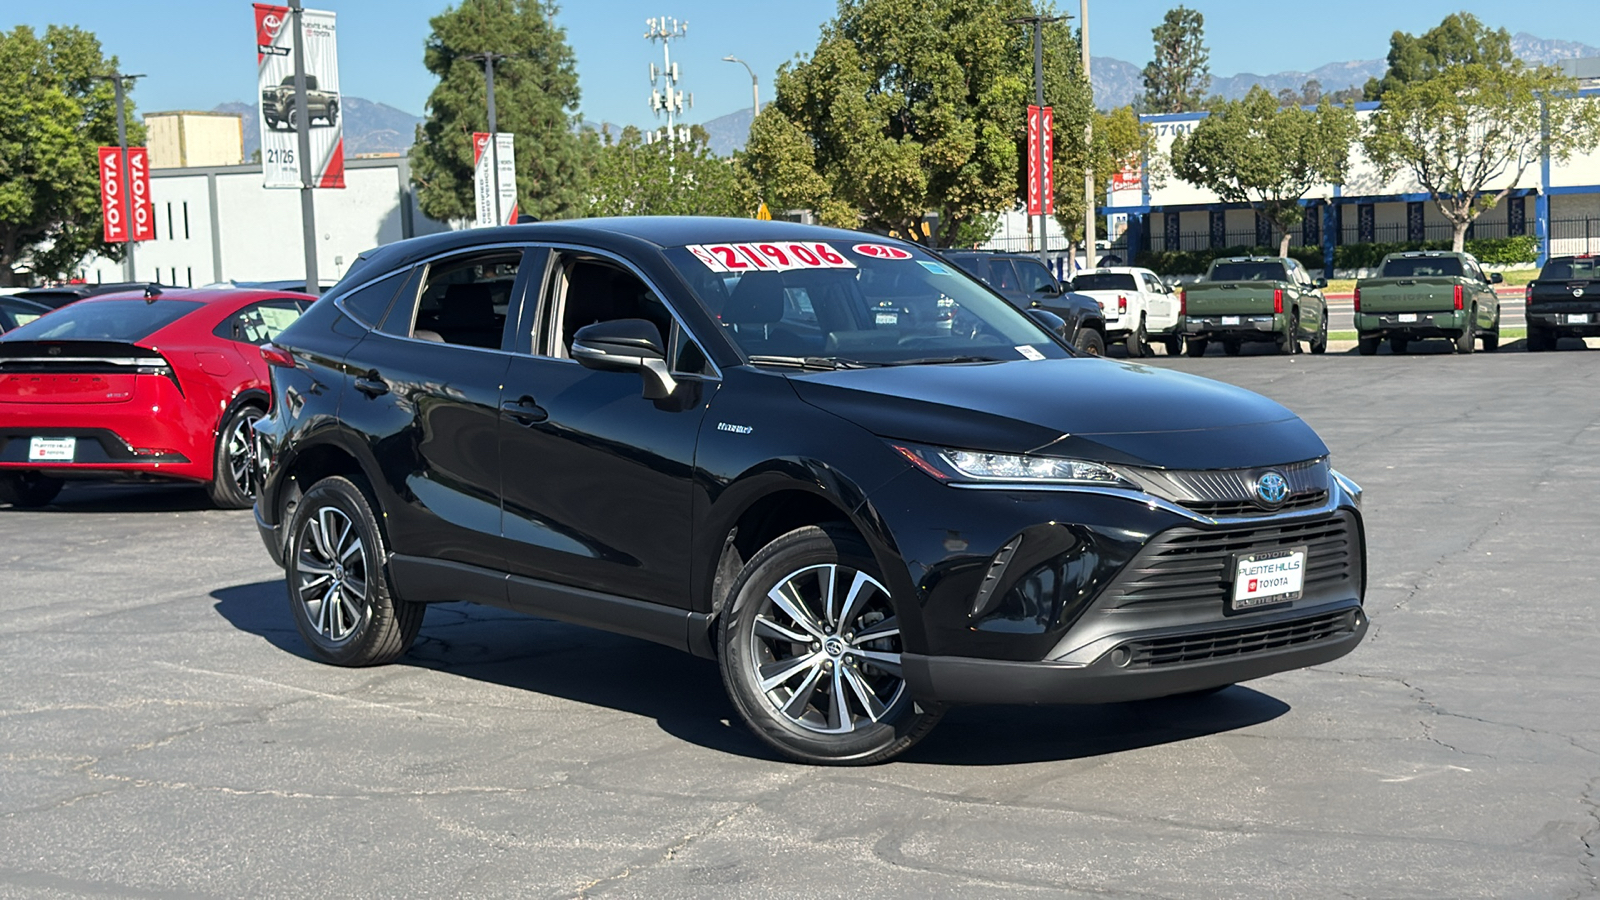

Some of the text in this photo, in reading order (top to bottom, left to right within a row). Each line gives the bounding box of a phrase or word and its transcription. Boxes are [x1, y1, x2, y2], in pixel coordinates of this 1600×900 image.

[104, 153, 121, 237] TOYOTA
[131, 153, 148, 236] TOYOTA
[1238, 561, 1300, 577] PUENTE HILLS
[1259, 577, 1288, 588] TOYOTA
